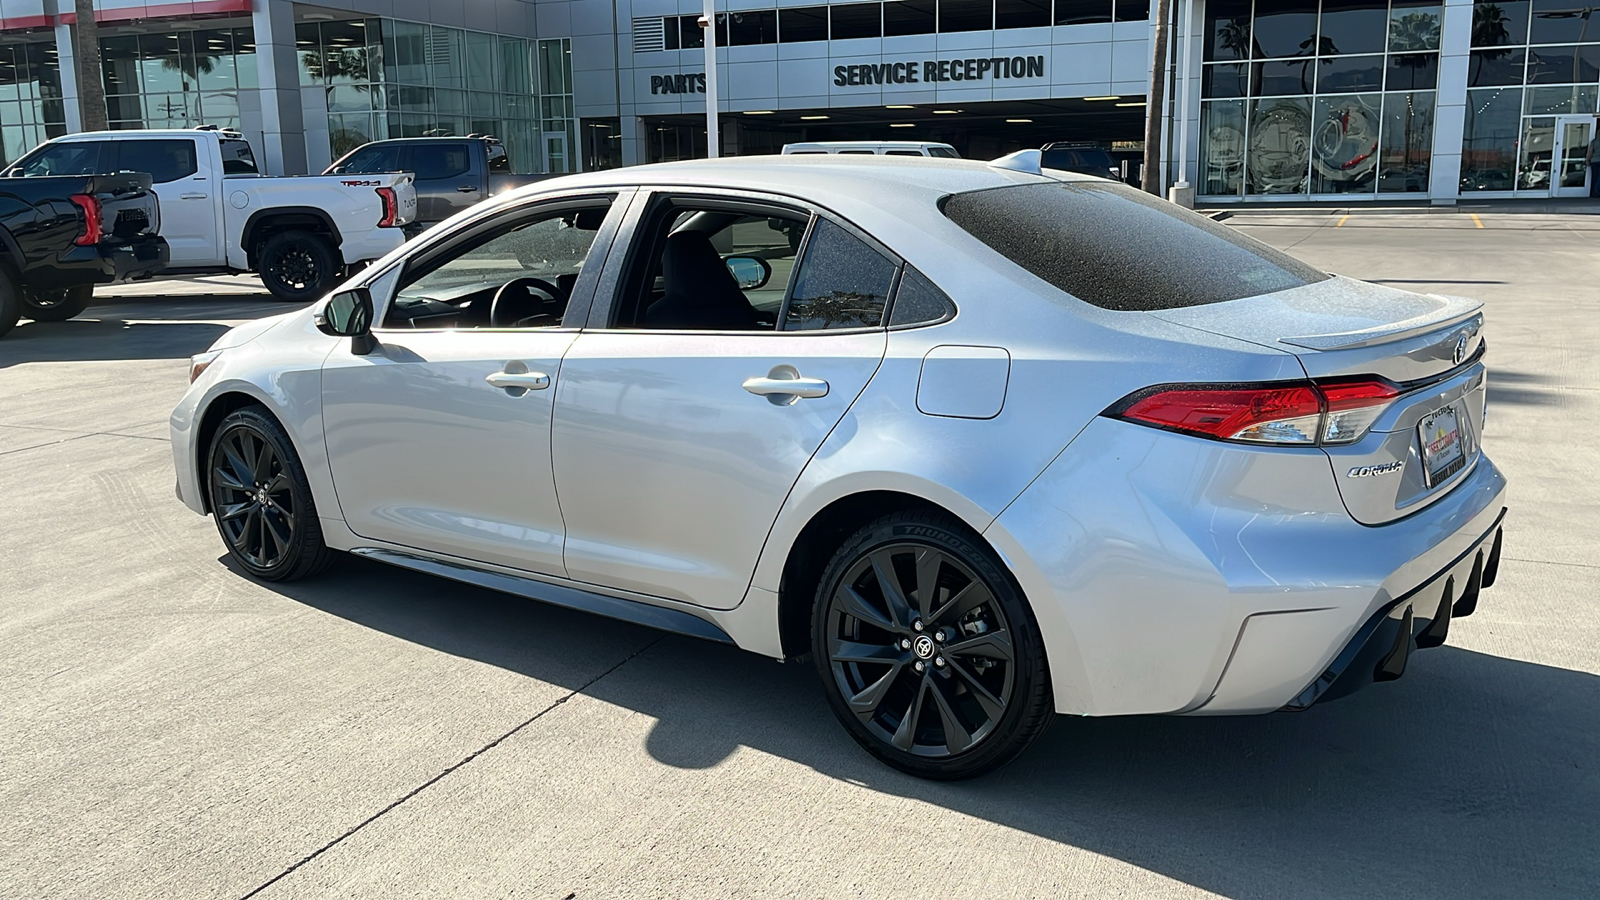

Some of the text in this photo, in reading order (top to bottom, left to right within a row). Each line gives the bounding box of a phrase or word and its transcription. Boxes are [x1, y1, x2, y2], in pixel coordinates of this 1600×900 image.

[651, 73, 706, 94] PARTS
[834, 56, 1043, 86] SERVICE RECEPTION
[1347, 460, 1402, 478] COROLLA
[903, 525, 1002, 584] THUNDERER
